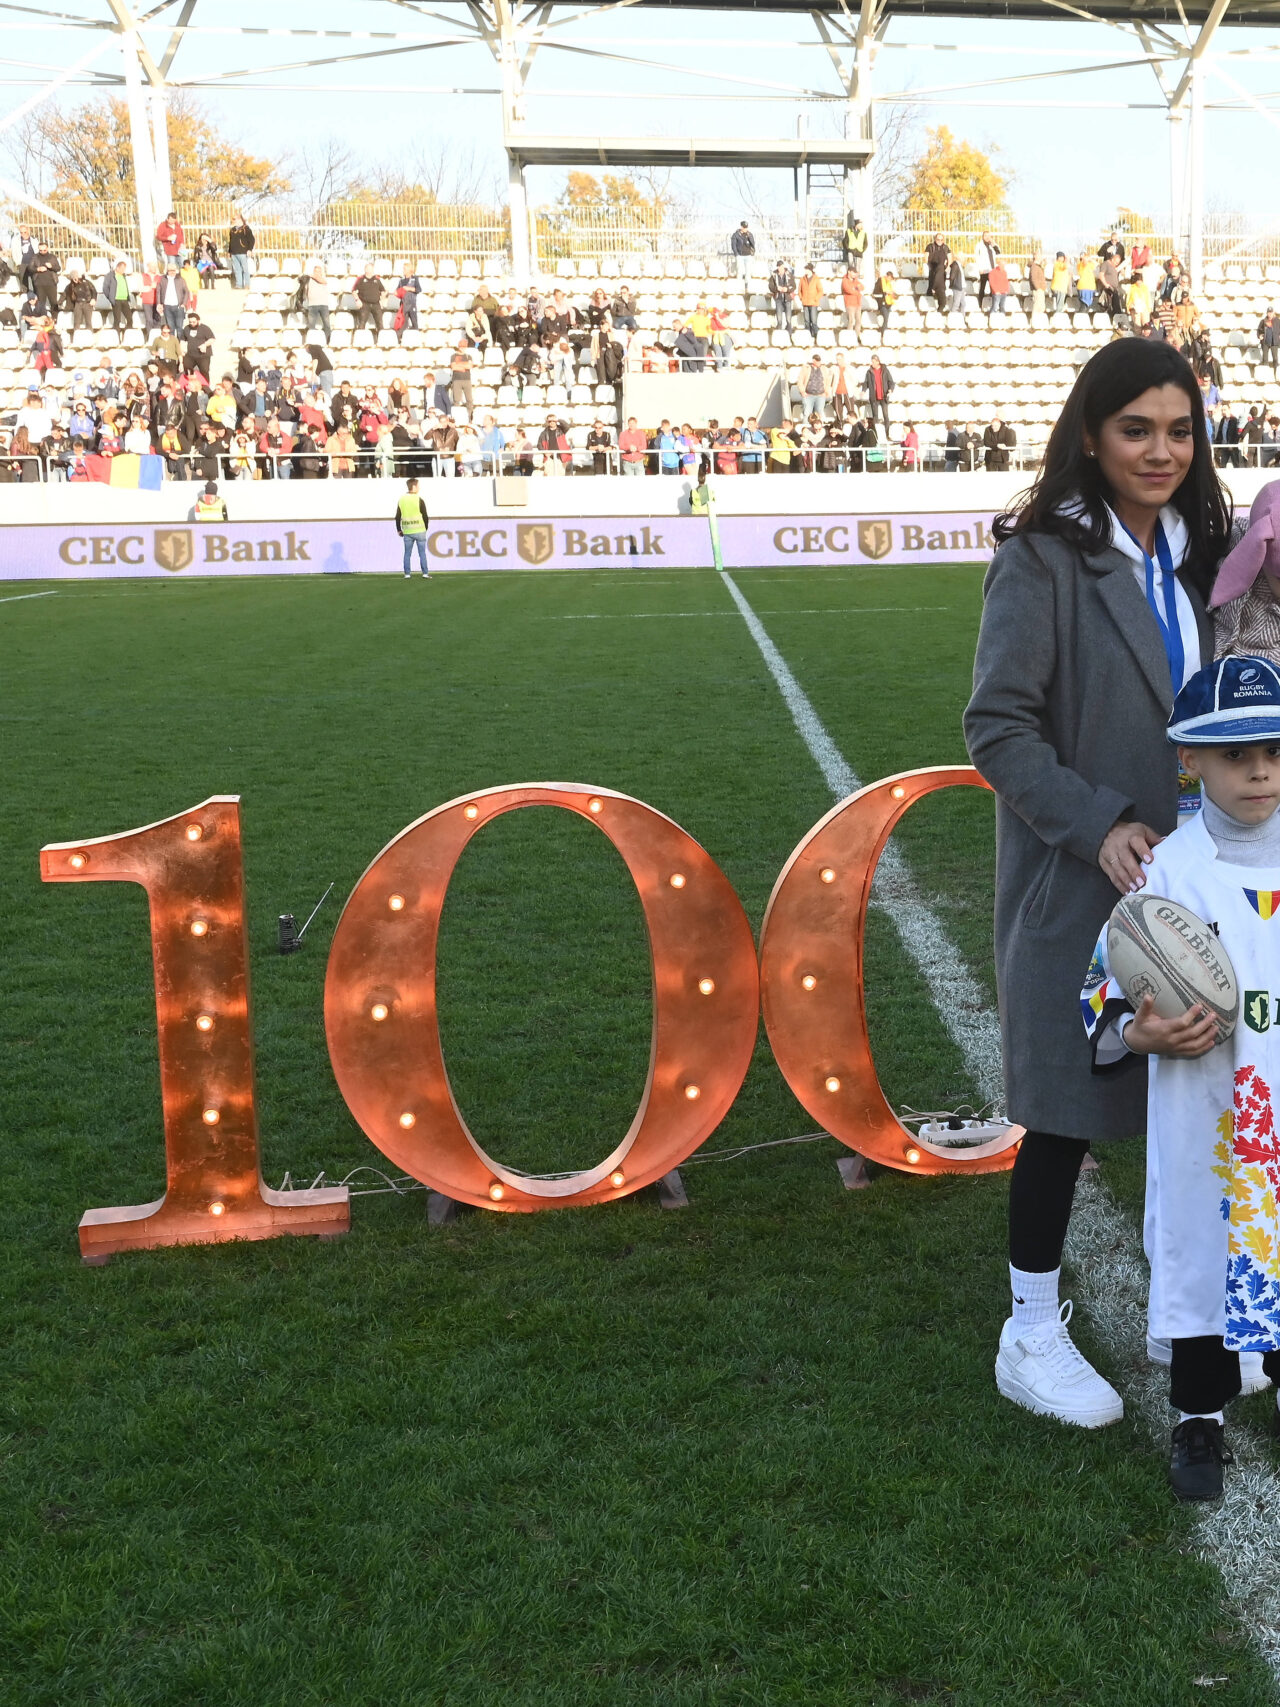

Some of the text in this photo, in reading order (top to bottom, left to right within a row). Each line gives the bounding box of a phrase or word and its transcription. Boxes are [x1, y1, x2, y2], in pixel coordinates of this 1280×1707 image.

[59, 531, 311, 565] CEC Bank
[427, 526, 665, 558] CEC Bank
[773, 520, 994, 553] CEC Bank
[1156, 907, 1231, 991] GILBERT
